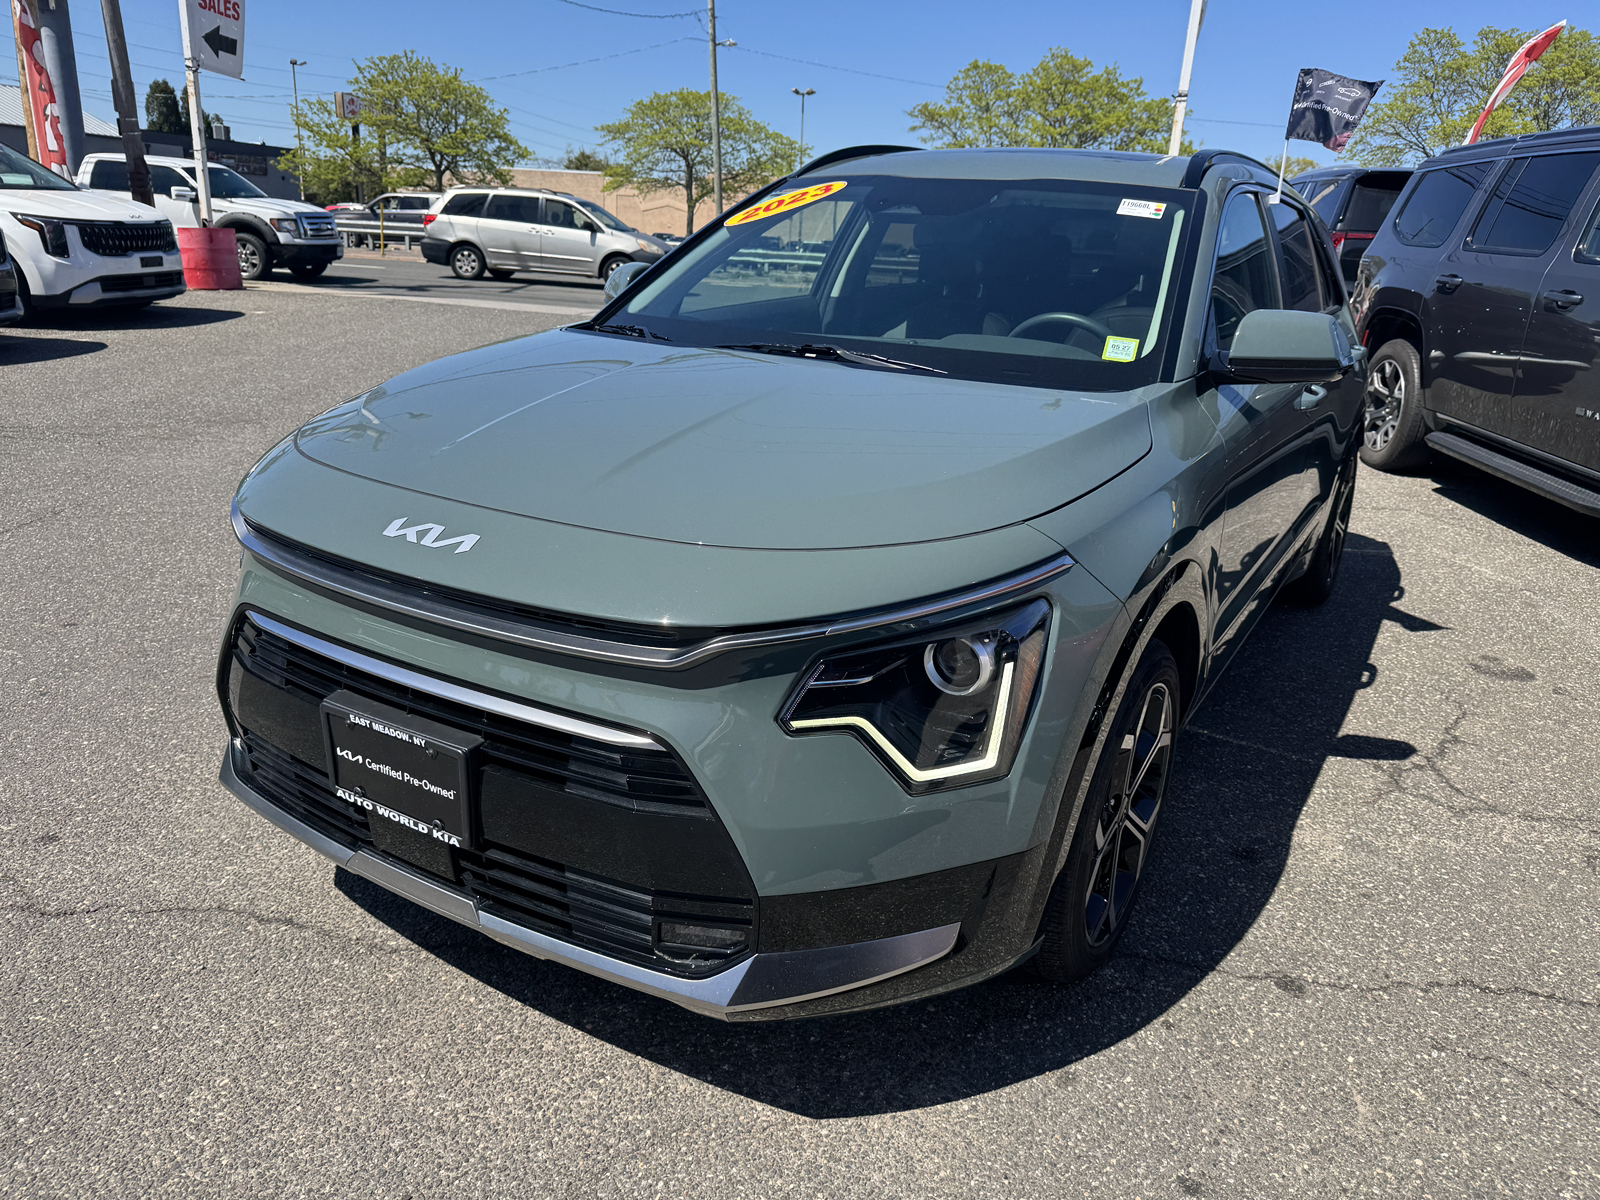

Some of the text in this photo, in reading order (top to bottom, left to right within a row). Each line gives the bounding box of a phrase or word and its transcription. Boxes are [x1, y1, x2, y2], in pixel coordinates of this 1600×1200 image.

[198, 0, 240, 21] SALES
[737, 184, 833, 223] 2023
[382, 516, 481, 554] KIA
[349, 714, 370, 728] EAST
[413, 736, 426, 748] NY
[336, 747, 363, 764] KIA
[365, 758, 402, 780] Certified
[336, 789, 460, 848] AUTO WORLD KIA
